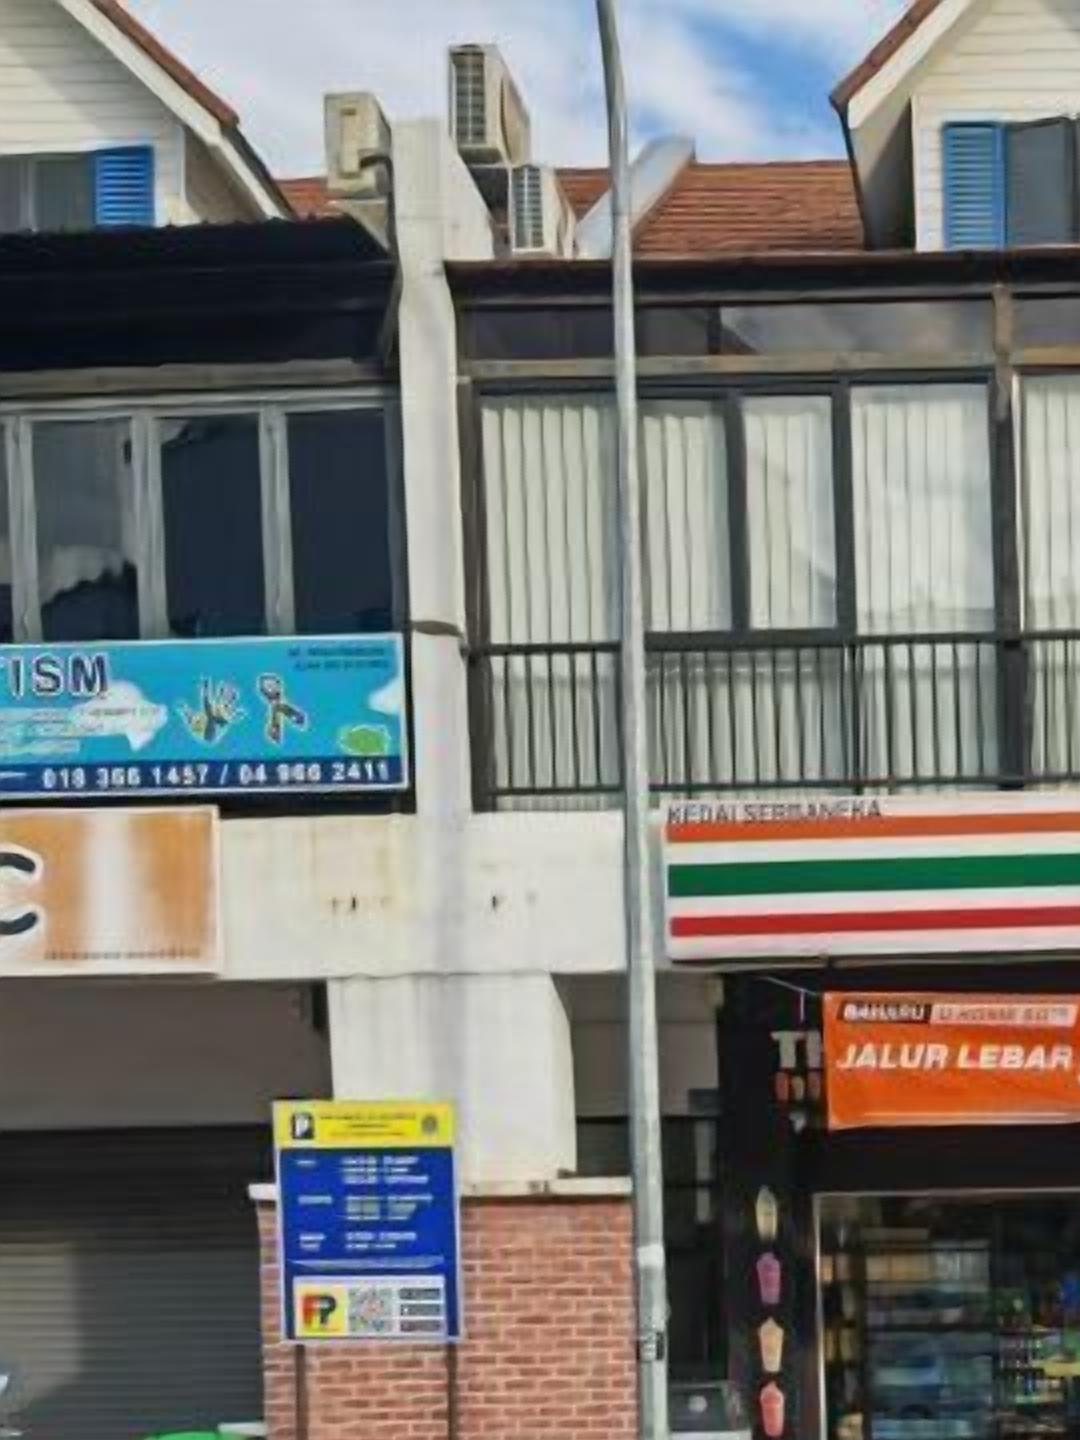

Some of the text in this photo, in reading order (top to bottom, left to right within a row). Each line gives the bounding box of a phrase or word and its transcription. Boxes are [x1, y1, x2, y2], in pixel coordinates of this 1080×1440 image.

[0, 652, 109, 698] ISM
[836, 1043, 949, 1070] JALUR
[957, 1044, 1074, 1071] LEBAR
